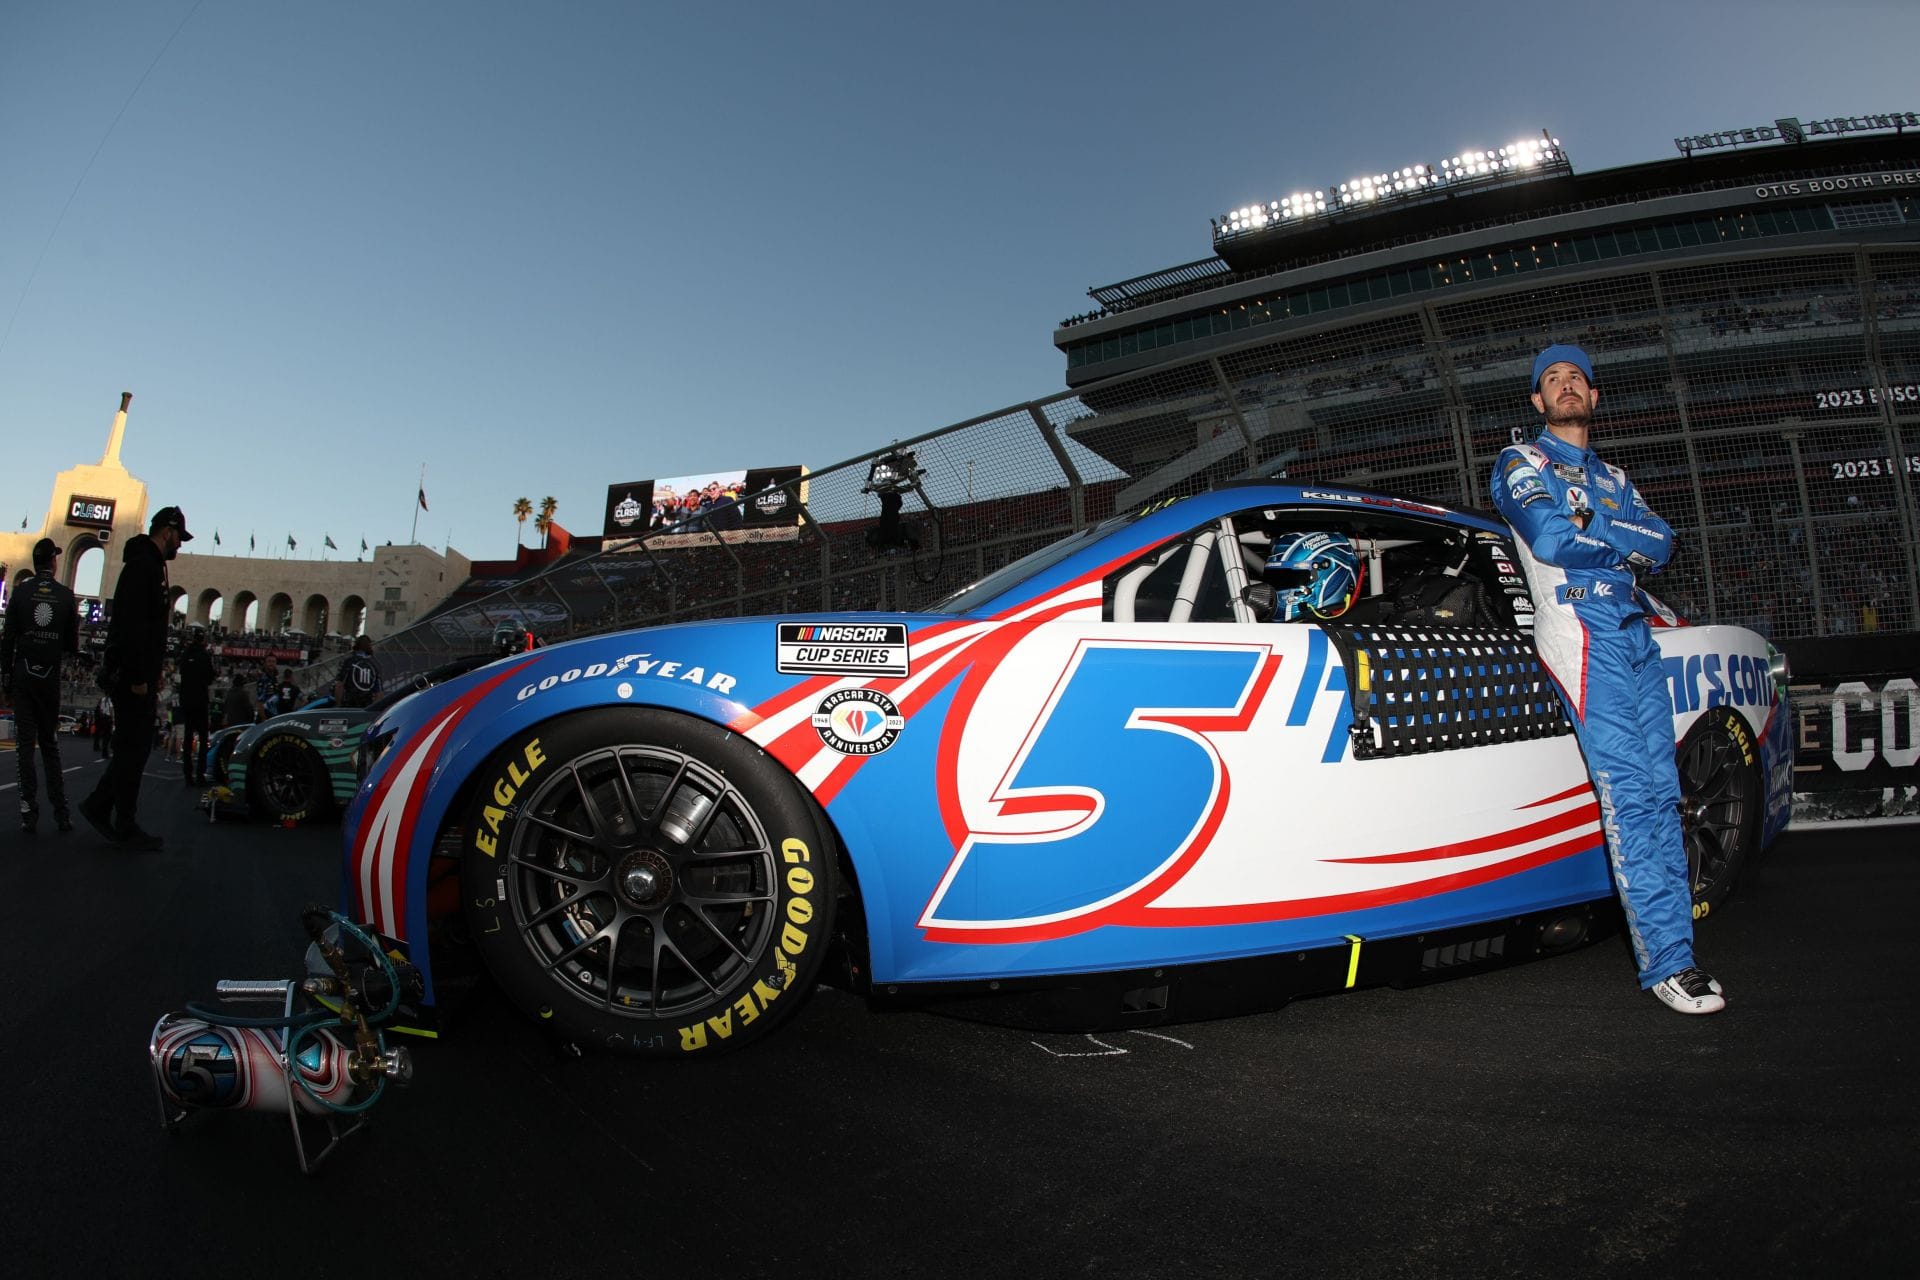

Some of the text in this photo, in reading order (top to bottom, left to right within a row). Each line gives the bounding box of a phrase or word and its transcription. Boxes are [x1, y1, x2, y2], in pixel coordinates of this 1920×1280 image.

[1674, 112, 1919, 151] UNITED AIRLINES
[1755, 183, 1801, 198] OTIS
[1808, 175, 1874, 192] BOOTH
[1816, 389, 1864, 408] 2023
[1832, 460, 1881, 479] 2023
[72, 502, 111, 520] CLASH
[615, 508, 640, 518] CLASH
[819, 627, 888, 643] NASCAR
[796, 648, 890, 664] CUP SERIES
[516, 654, 738, 701] GOODYEAR
[824, 690, 893, 712] NASCAR 75TH
[823, 729, 894, 753] ANNIVERSARY
[1724, 714, 1755, 768] EAGLE
[476, 738, 548, 858] EAGLE
[916, 638, 1278, 940] 5
[678, 837, 815, 1051] GOODYEAR
